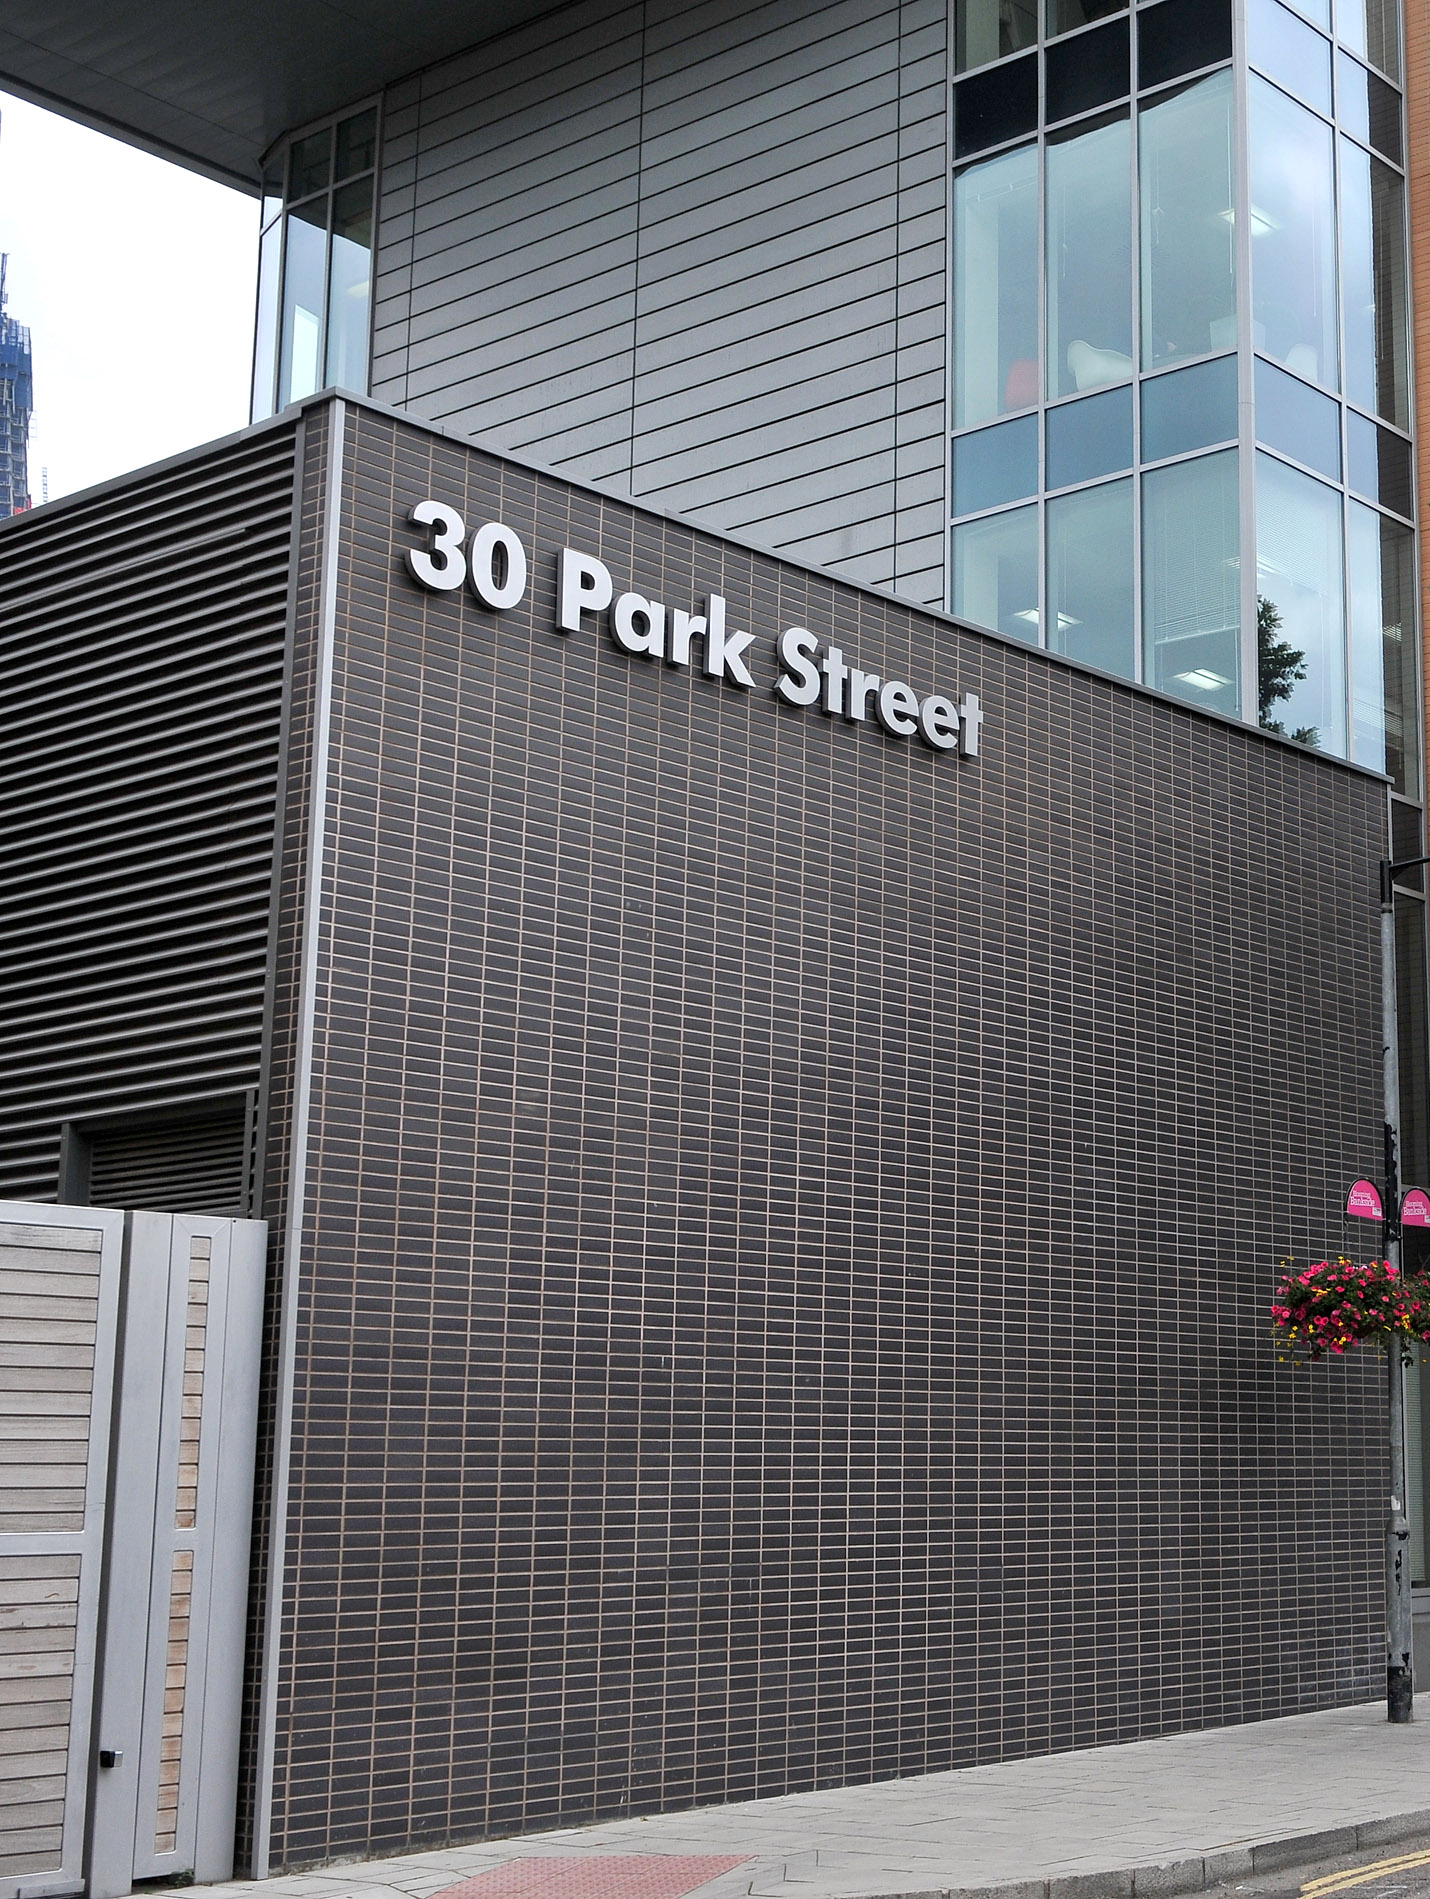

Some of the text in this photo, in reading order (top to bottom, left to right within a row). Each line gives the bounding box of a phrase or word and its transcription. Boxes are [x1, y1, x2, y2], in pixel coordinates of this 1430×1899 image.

[405, 500, 984, 757] 30 Park Street
